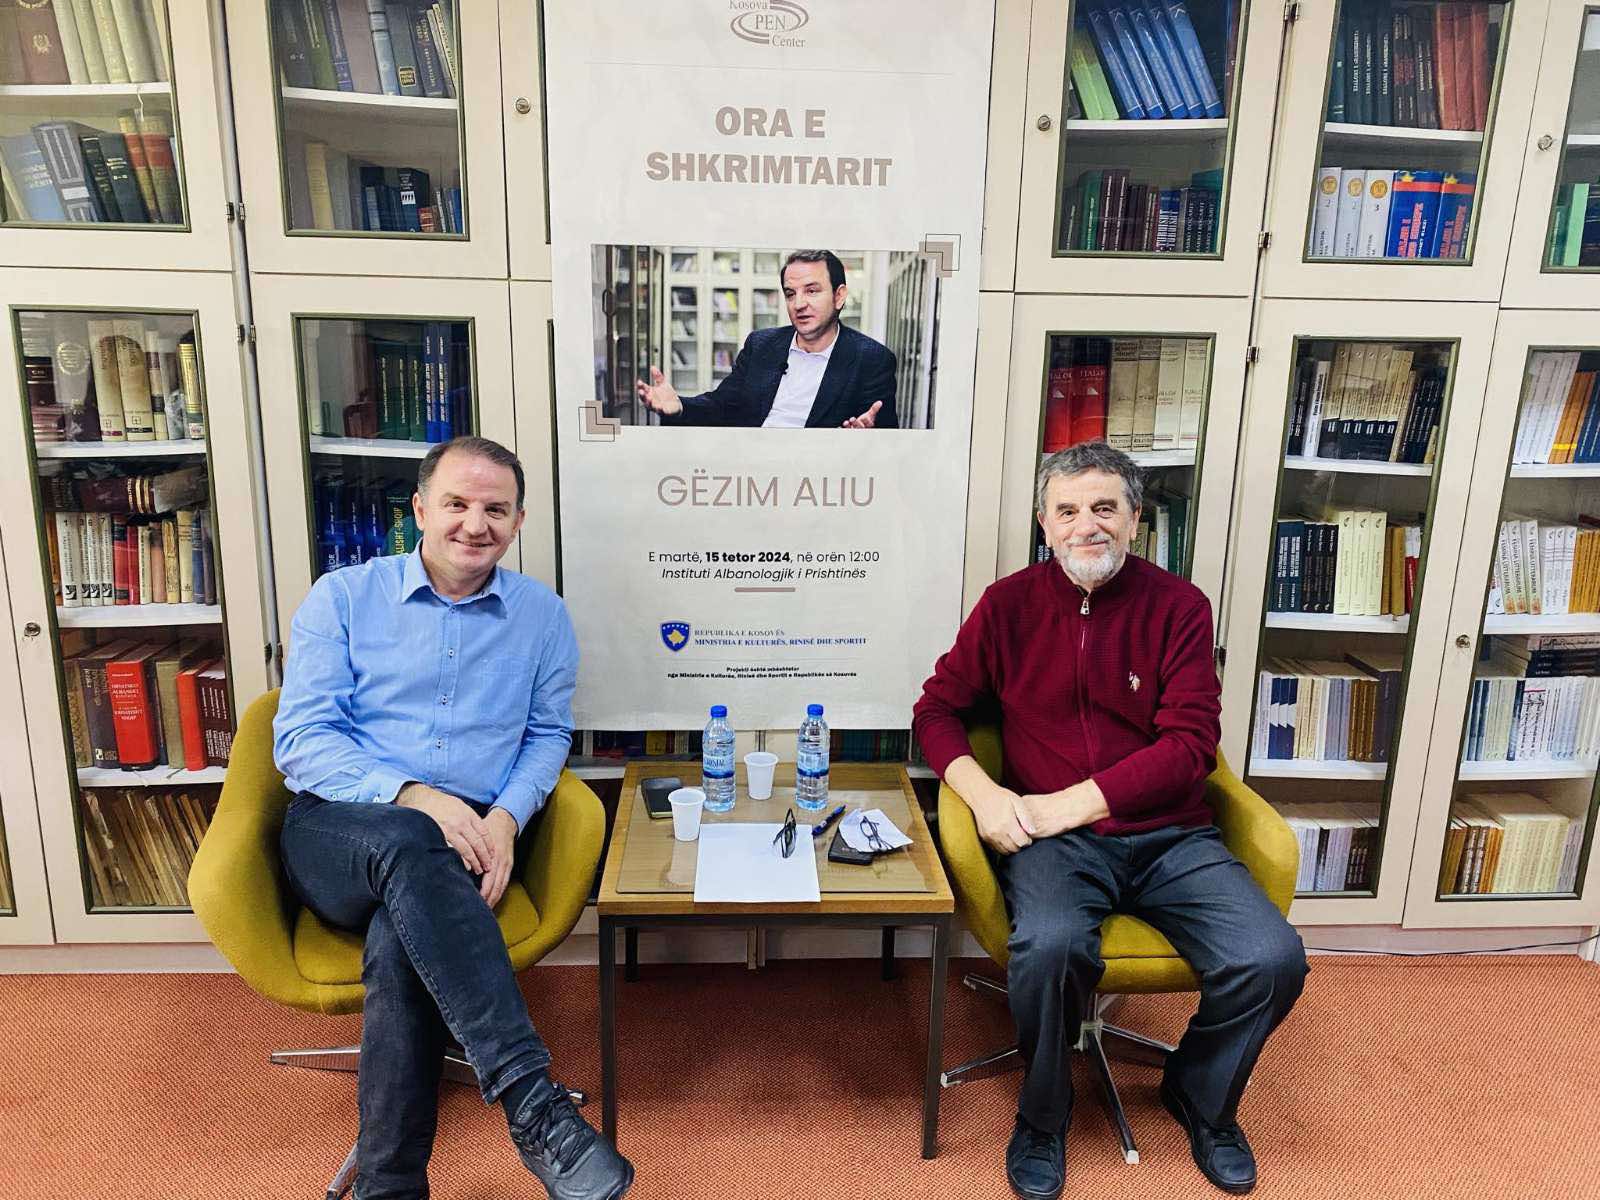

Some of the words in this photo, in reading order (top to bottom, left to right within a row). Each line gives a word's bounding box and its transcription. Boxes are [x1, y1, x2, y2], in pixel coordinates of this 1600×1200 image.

[729, 0, 768, 9] Kosova
[755, 15, 786, 31] PEN
[772, 35, 806, 48] Center
[715, 106, 794, 138] ORA
[805, 109, 826, 138] E
[646, 152, 892, 186] SHKRIMTARIT
[658, 469, 778, 506] GËZIM
[793, 477, 875, 506] ALIU
[649, 552, 655, 562] E
[659, 551, 703, 564] martë,
[706, 552, 720, 562] 15
[723, 552, 756, 562] tetor
[758, 552, 793, 564] 2024,
[797, 551, 812, 562] në
[816, 551, 846, 562] orën
[850, 551, 880, 562] 12:00
[662, 568, 711, 579] Instituti
[714, 568, 795, 582] Albanologjik
[798, 568, 801, 579] i
[805, 568, 867, 579] Prishtinës
